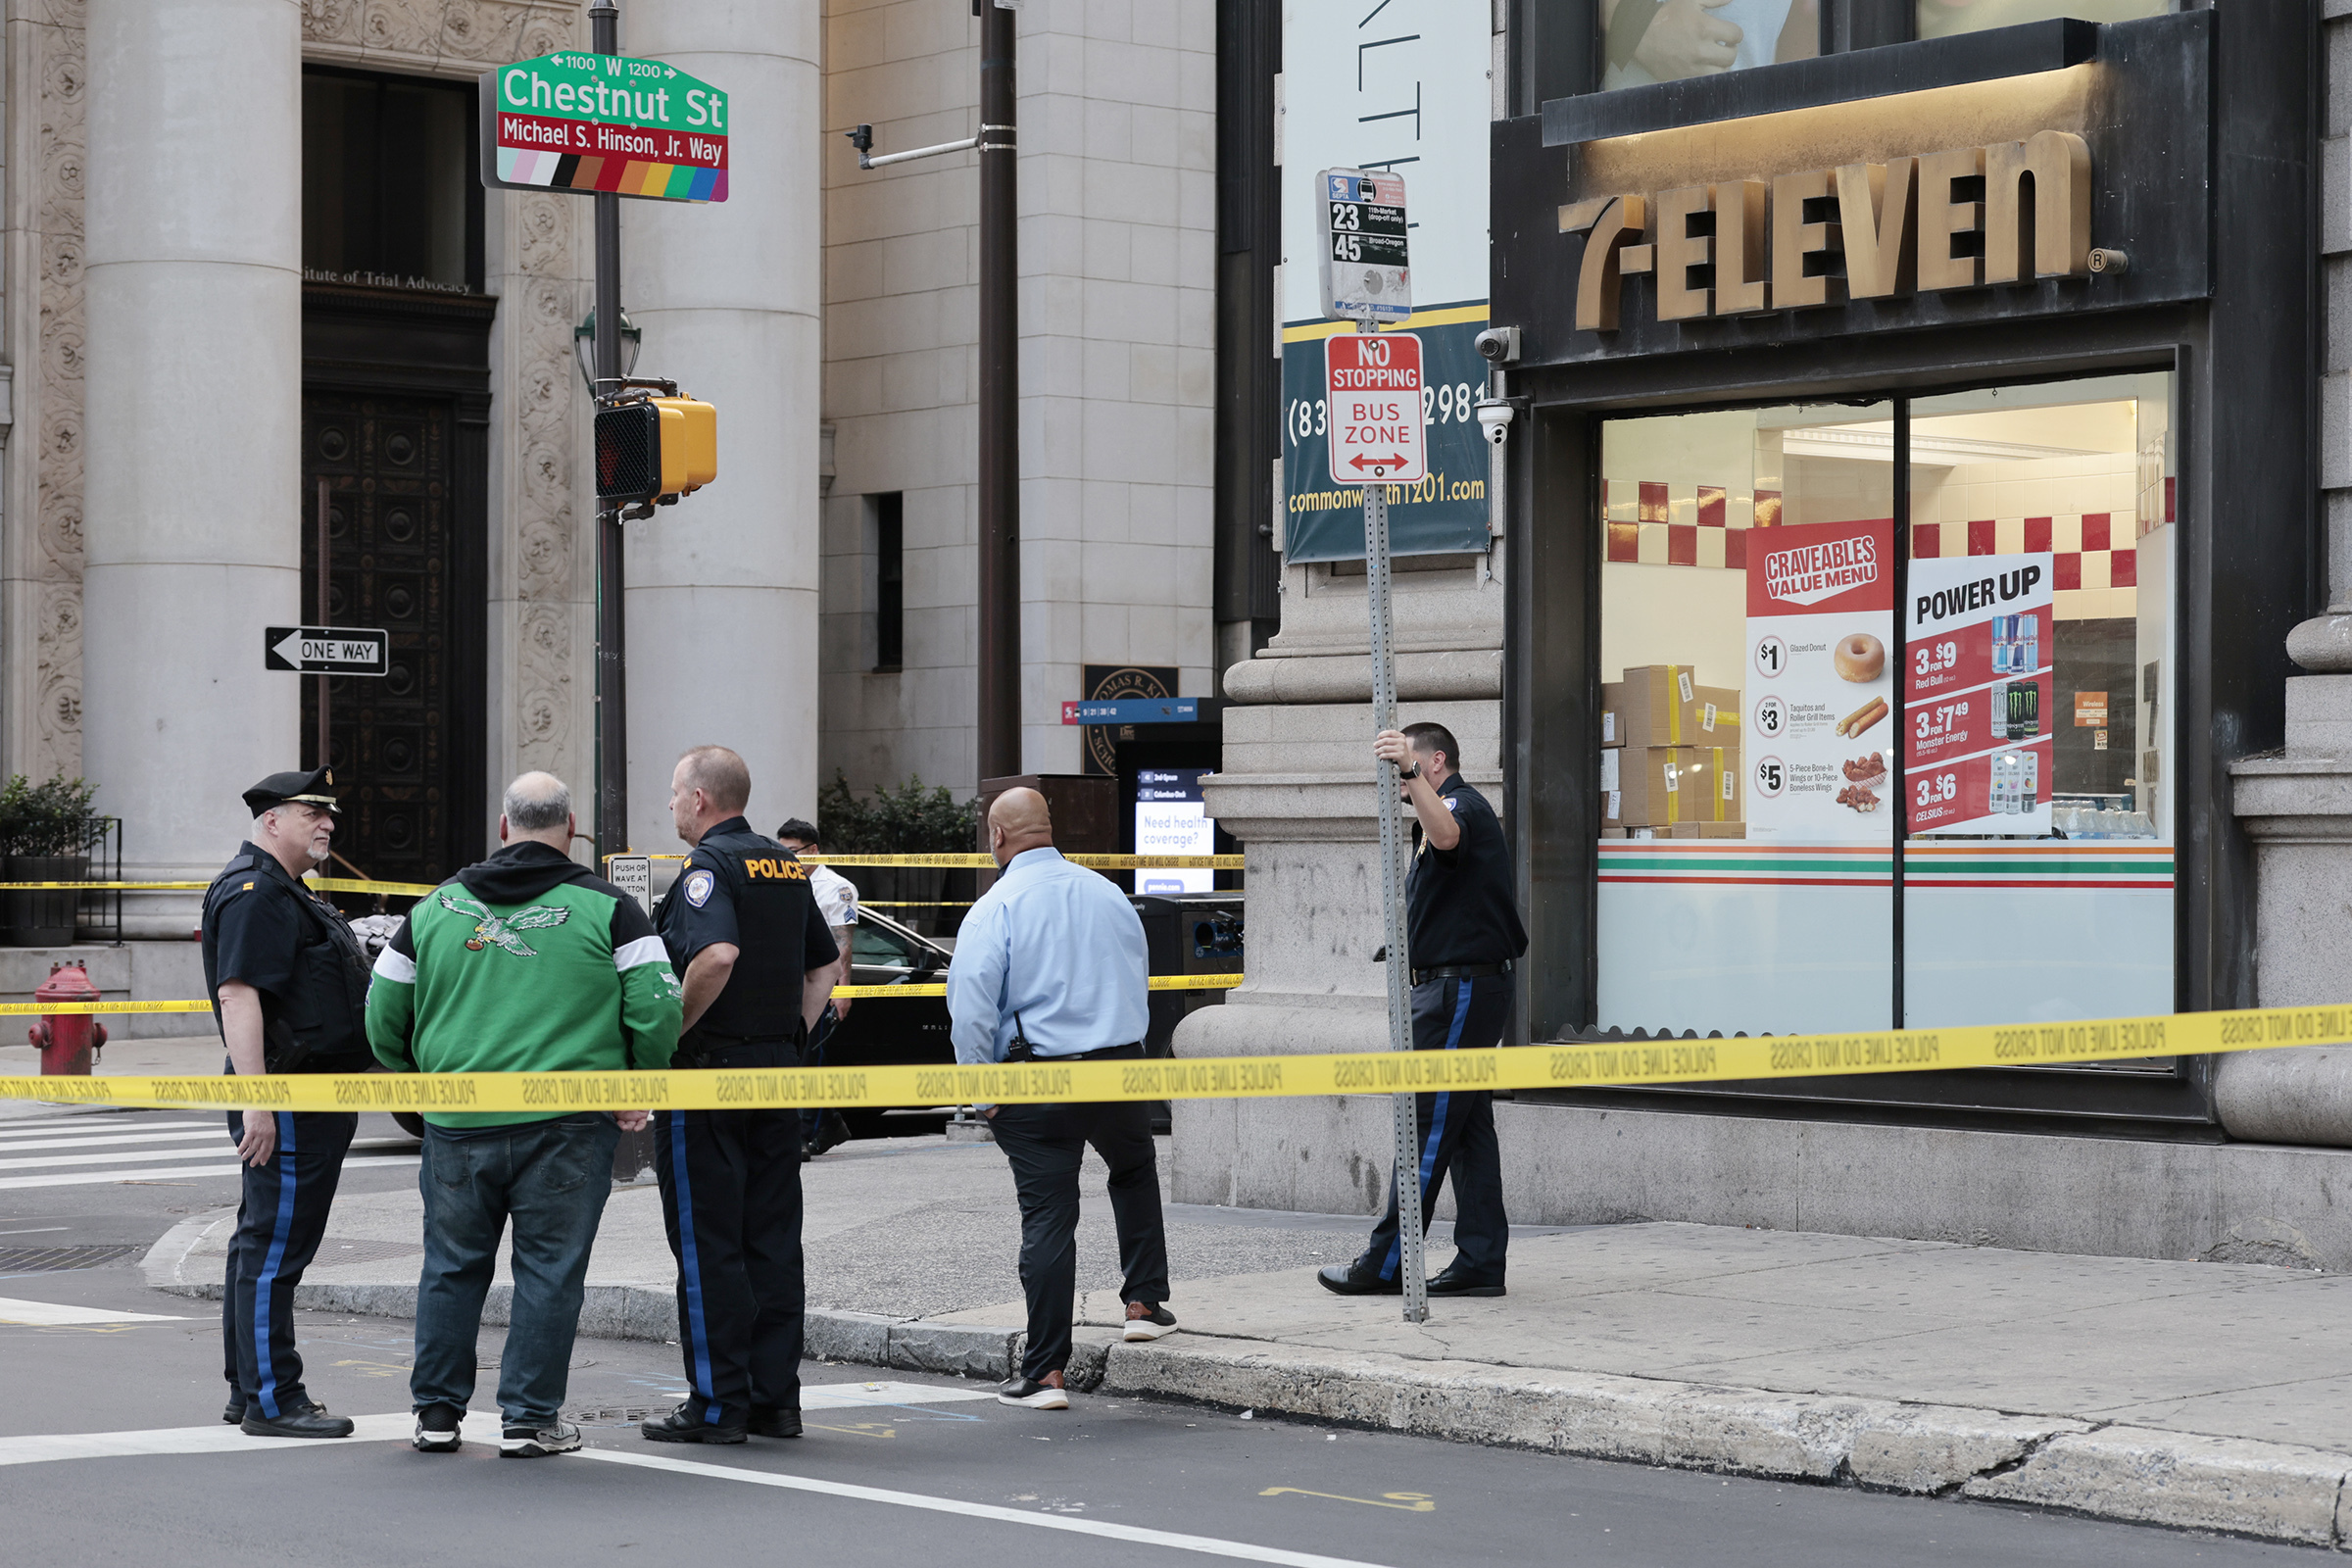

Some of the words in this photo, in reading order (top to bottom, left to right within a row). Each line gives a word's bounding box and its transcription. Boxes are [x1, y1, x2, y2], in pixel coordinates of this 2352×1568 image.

[565, 55, 597, 72] 1100
[605, 57, 622, 76] W
[627, 63, 662, 78] 1200
[504, 69, 669, 122] Chestnut
[686, 89, 722, 128] St
[504, 117, 569, 146] Michael
[575, 124, 591, 148] S.
[598, 127, 659, 157] Hinson,
[664, 135, 684, 158] Jr.
[689, 137, 723, 167] Way
[1333, 203, 1360, 231] 23
[1335, 234, 1361, 262] 45
[1369, 237, 1404, 247] Broad-Oregon
[302, 266, 338, 282] itute
[343, 270, 360, 283] of
[364, 270, 399, 287] Trial
[406, 274, 471, 296] Advocacy
[1357, 339, 1391, 367] NO
[1333, 368, 1417, 388] STOPPING
[1289, 398, 1327, 448] (83
[1423, 381, 1486, 425] 2981
[1352, 403, 1400, 421] BUS
[1345, 425, 1410, 444] ZONE
[1289, 471, 1485, 513] commonwth1201.com
[1766, 536, 1876, 580] CRAVEABLES
[1769, 573, 1822, 598] VALUE
[1825, 564, 1877, 588] MENU
[1917, 577, 1995, 625] POWER
[1999, 564, 2041, 601] UP
[302, 641, 335, 659] ONE
[342, 643, 373, 661] WAY
[1761, 644, 1778, 670] $1
[1789, 644, 1809, 653] Glazed
[1809, 643, 1827, 652] Donut
[1936, 641, 1957, 668] $9
[1916, 648, 1930, 675] 3
[1931, 662, 1942, 672] FOR
[1098, 675, 1132, 701] OMAS
[1915, 677, 1930, 690] Red
[1931, 673, 1943, 686] Bull
[1789, 704, 1814, 712] Taquitos
[1815, 703, 1826, 711] and
[1806, 712, 1819, 721] Grill
[1119, 727, 1135, 736] Dre
[1761, 709, 1778, 731] $3
[1916, 711, 1931, 739] 3
[1931, 725, 1943, 736] FOR
[1916, 736, 1945, 751] Monster
[1945, 730, 1969, 744] Energy
[1760, 763, 1782, 791] $5
[1789, 774, 1806, 783] Wings
[1814, 773, 1838, 782] 10-Piece
[1811, 763, 1834, 772] Bone-In
[1815, 784, 1833, 793] Wings
[1917, 779, 1931, 807] 3
[1936, 773, 1957, 800] $6
[1931, 793, 1942, 804] FOR
[1144, 815, 1170, 829] Need
[1174, 815, 1208, 829] health
[1916, 807, 1943, 822] CELSIUS
[1144, 831, 1199, 849] coverage?
[745, 858, 807, 881] POLICE
